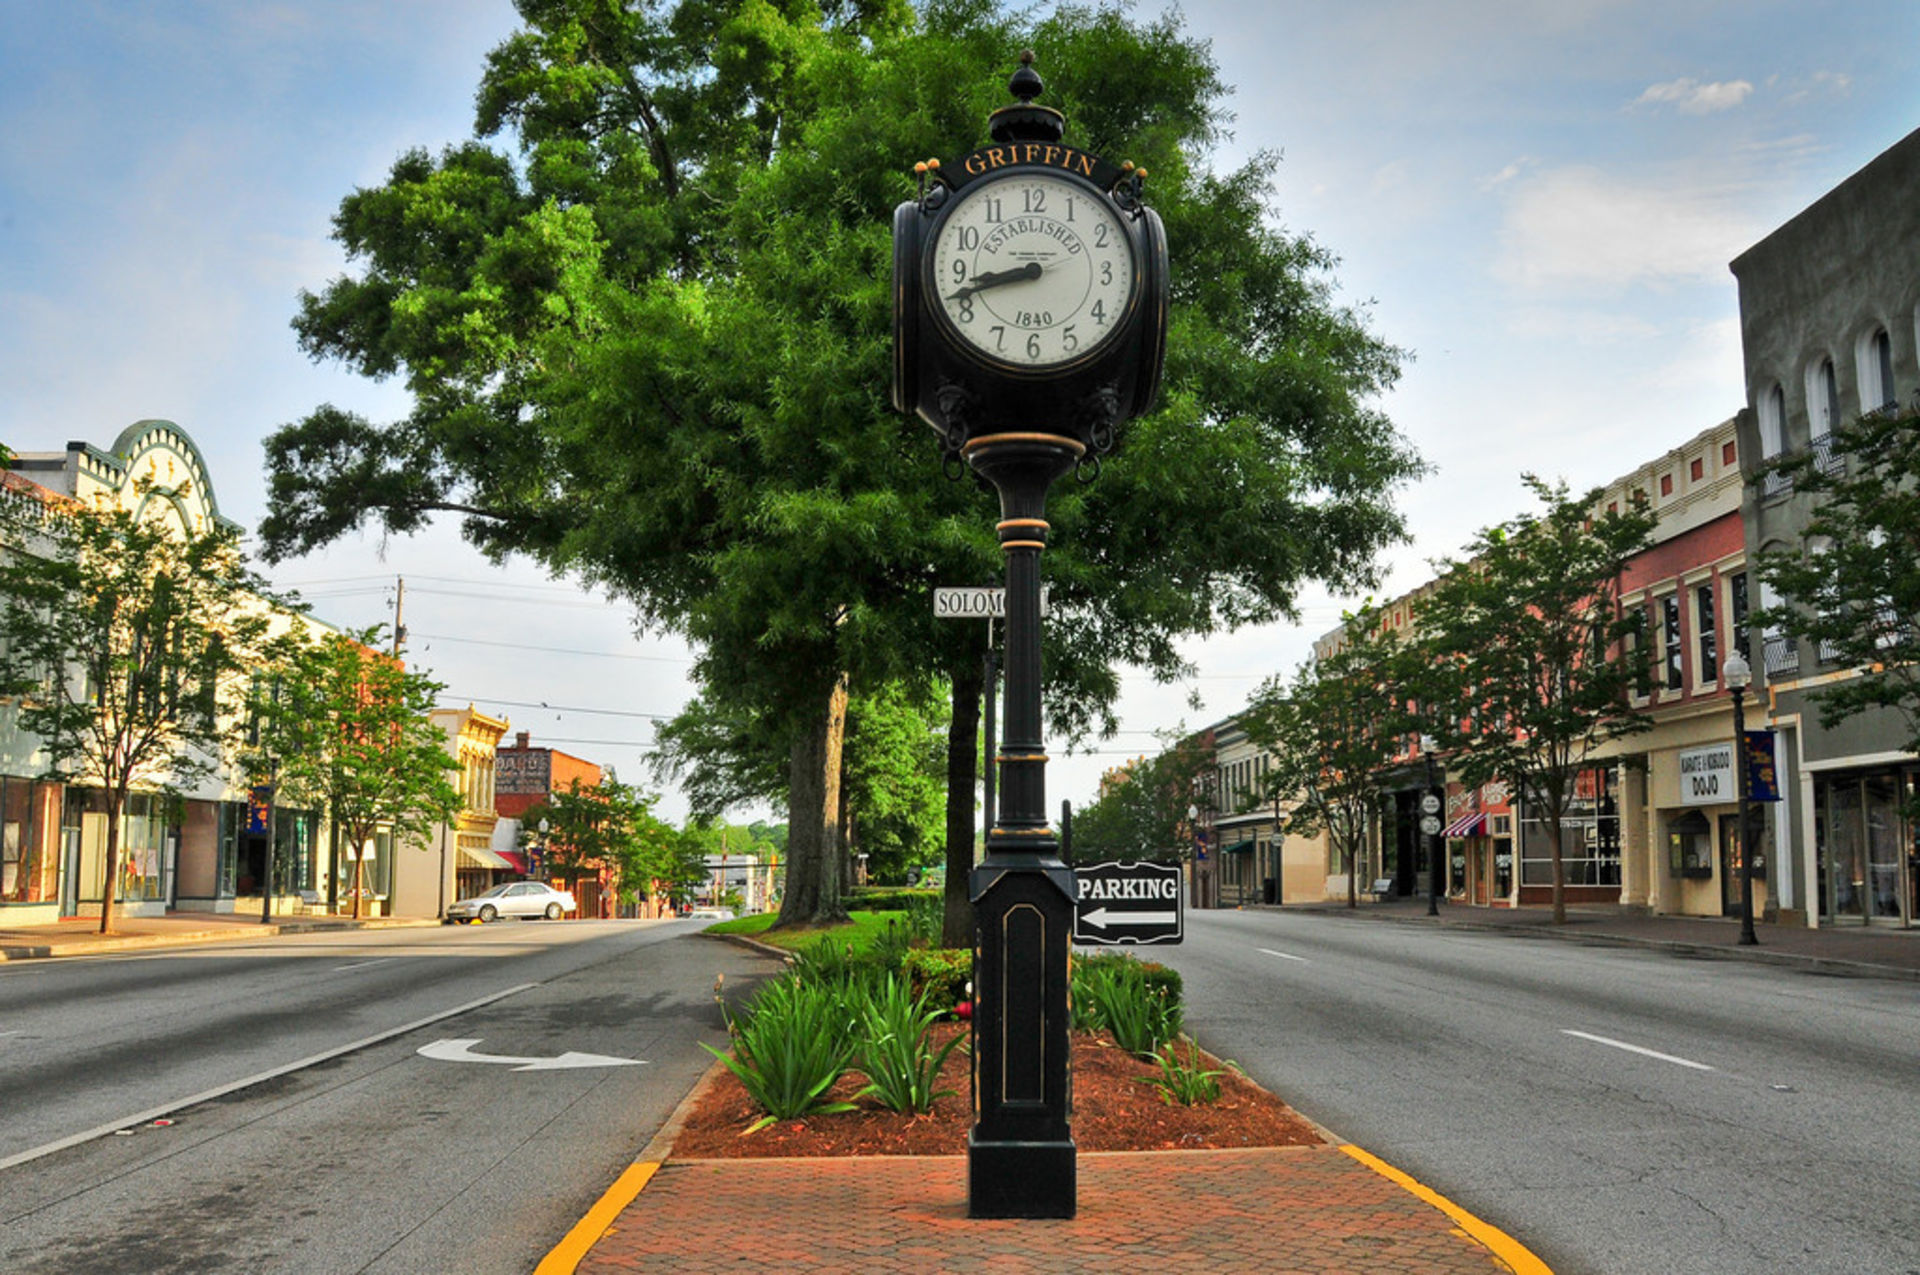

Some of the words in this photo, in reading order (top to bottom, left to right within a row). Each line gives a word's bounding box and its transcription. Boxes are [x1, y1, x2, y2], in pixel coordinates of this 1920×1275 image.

[965, 143, 1097, 177] GRIFFIN
[986, 198, 1001, 223] 11
[1022, 188, 1047, 213] 12
[1066, 197, 1075, 222] 1
[957, 226, 979, 251] 10
[984, 218, 1082, 255] ESTABLISHED
[1094, 223, 1110, 249] 2
[953, 259, 967, 284] 9
[1101, 261, 1113, 286] 3
[959, 297, 974, 324] 8
[1015, 310, 1053, 327] 1840
[1091, 299, 1107, 325] 4
[989, 326, 1007, 353] 7
[1026, 333, 1040, 360] 6
[1062, 324, 1079, 352] 5
[938, 592, 1005, 614] SOLOM
[1692, 774, 1719, 796] DOJO
[1077, 878, 1177, 899] PARKING
